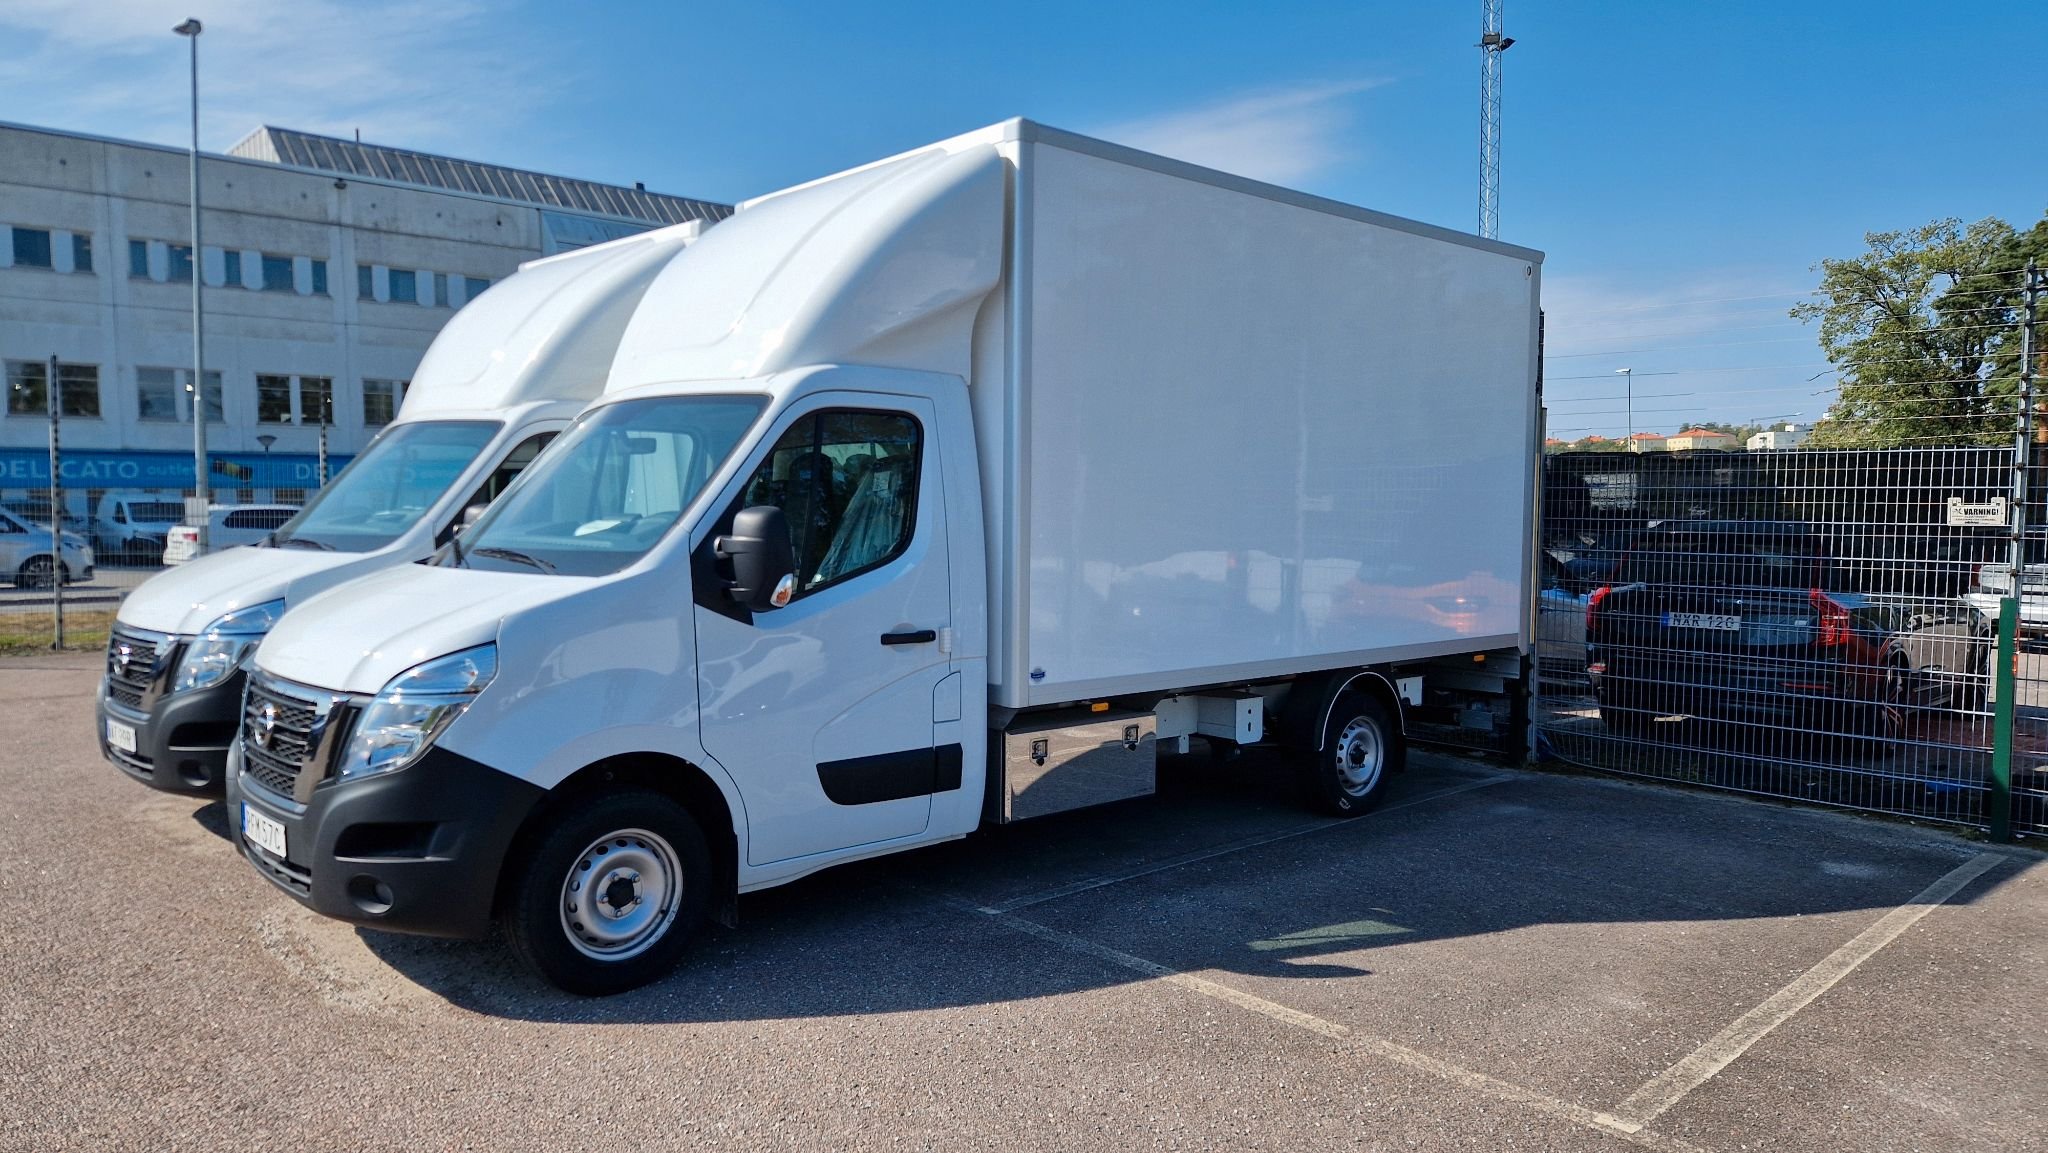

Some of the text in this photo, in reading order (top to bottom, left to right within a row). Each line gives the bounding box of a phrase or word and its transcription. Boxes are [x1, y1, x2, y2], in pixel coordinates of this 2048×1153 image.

[0, 459, 140, 479] ELCATO
[1963, 508, 1999, 516] VARNING!
[1672, 613, 1700, 627] NXR
